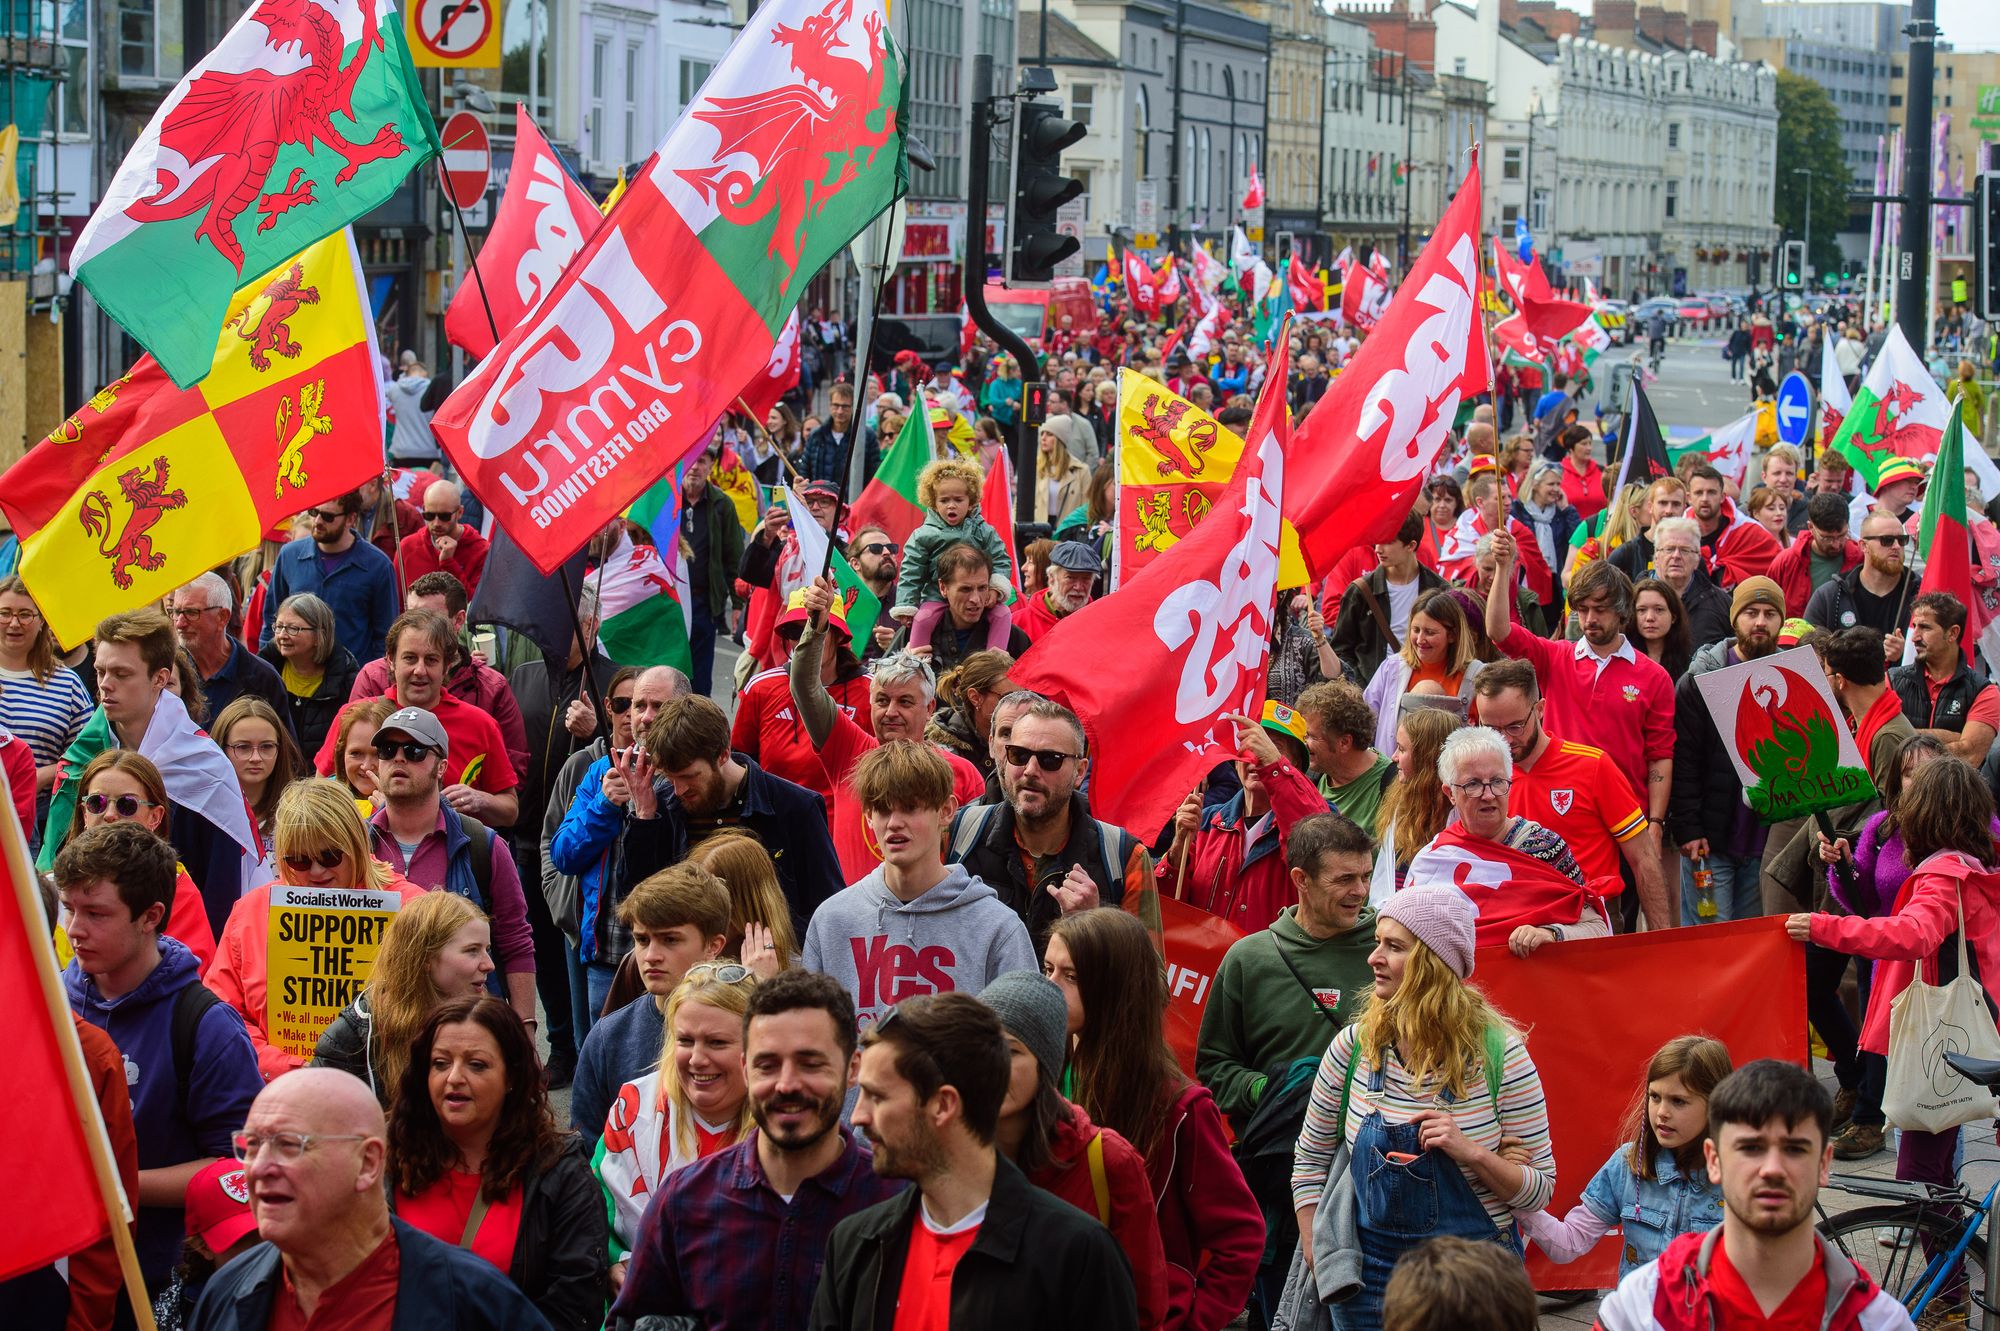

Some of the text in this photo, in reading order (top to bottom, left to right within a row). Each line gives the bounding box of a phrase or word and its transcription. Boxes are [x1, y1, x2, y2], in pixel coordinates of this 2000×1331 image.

[279, 912, 388, 945] SUPPORT
[310, 946, 354, 976] THE
[849, 934, 956, 1008] Yes
[283, 1011, 335, 1025] We all need
[283, 1029, 306, 1042] Make
[283, 1044, 298, 1056] and
